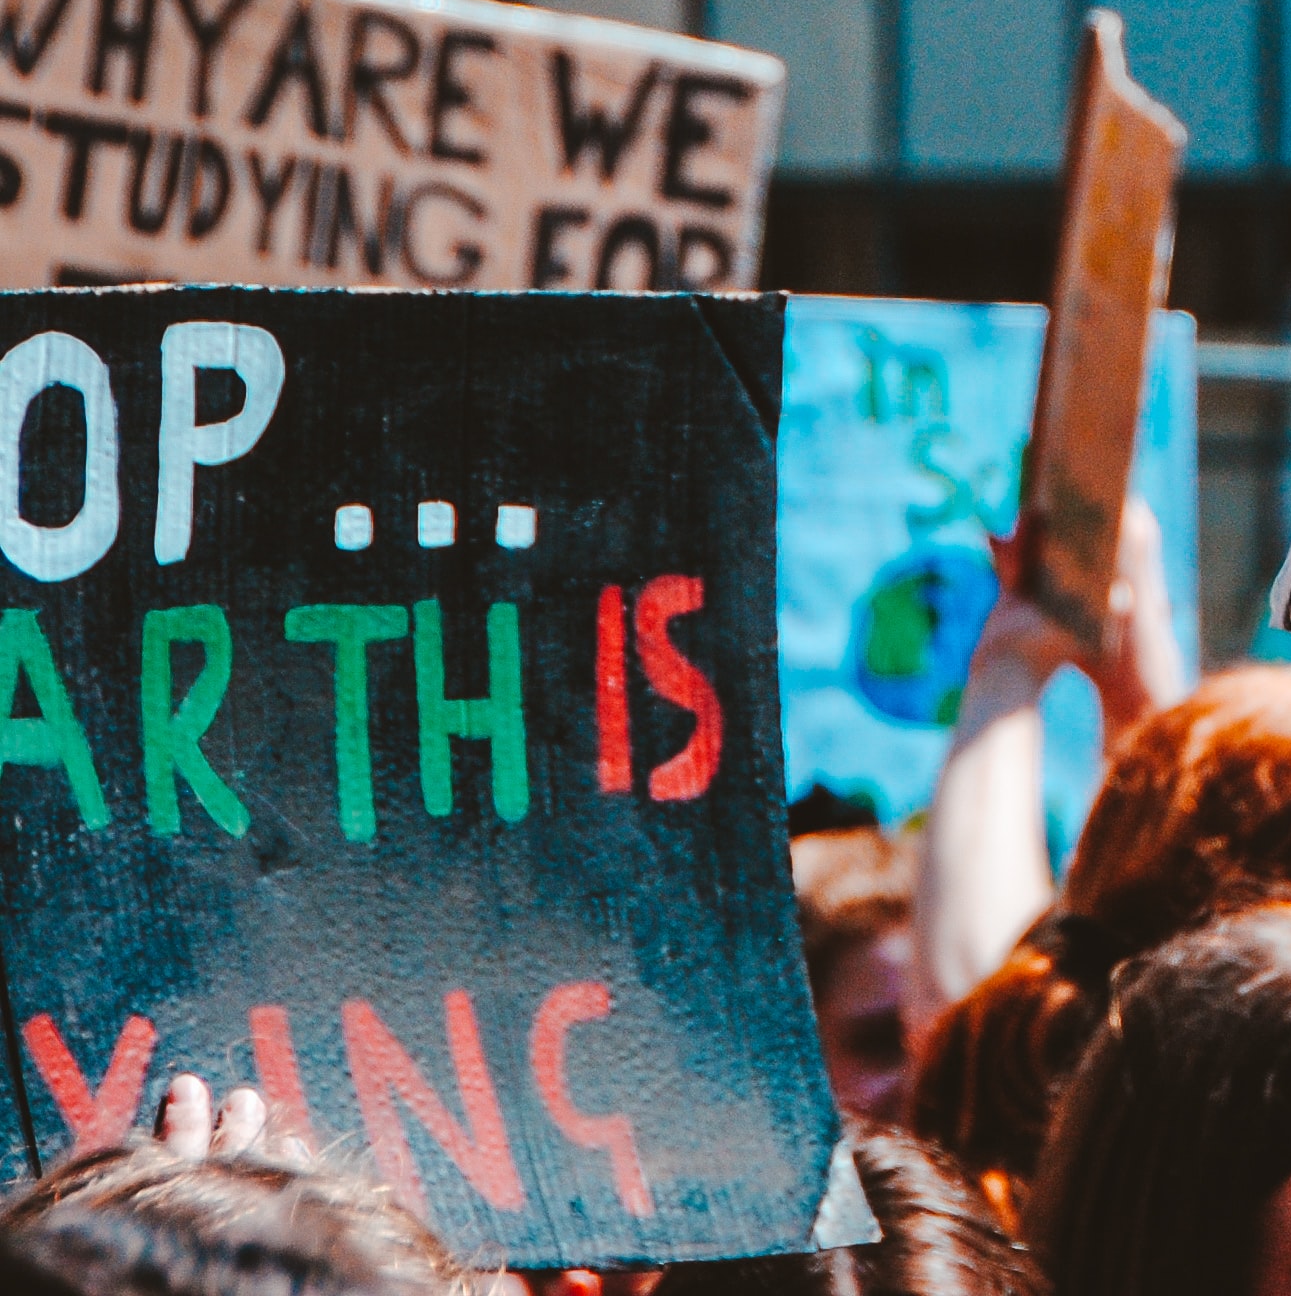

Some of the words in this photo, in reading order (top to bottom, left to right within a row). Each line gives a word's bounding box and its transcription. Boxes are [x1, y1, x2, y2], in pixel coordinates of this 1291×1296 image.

[246, 0, 497, 165] ARE
[550, 48, 757, 207] WE
[595, 574, 724, 803] IS
